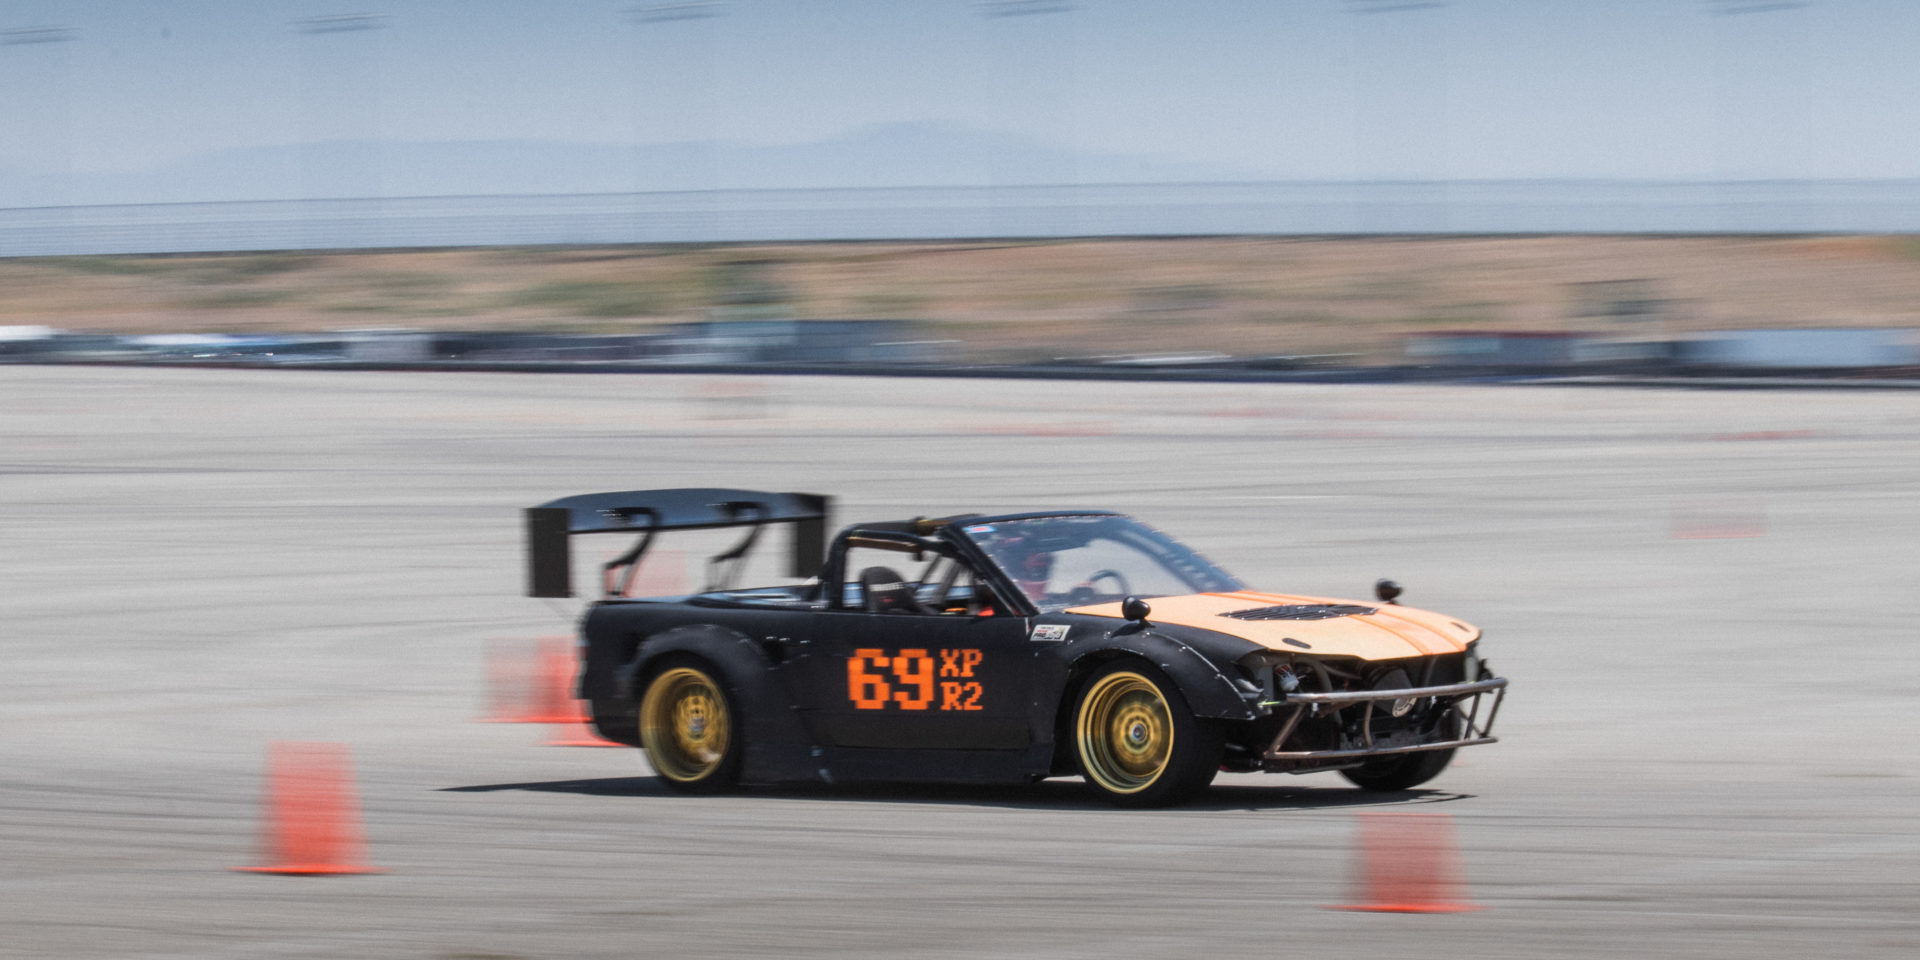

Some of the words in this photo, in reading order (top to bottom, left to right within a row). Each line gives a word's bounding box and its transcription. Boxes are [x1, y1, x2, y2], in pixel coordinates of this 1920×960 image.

[939, 648, 983, 678] XP
[848, 648, 935, 710] 69
[939, 682, 984, 710] R2
